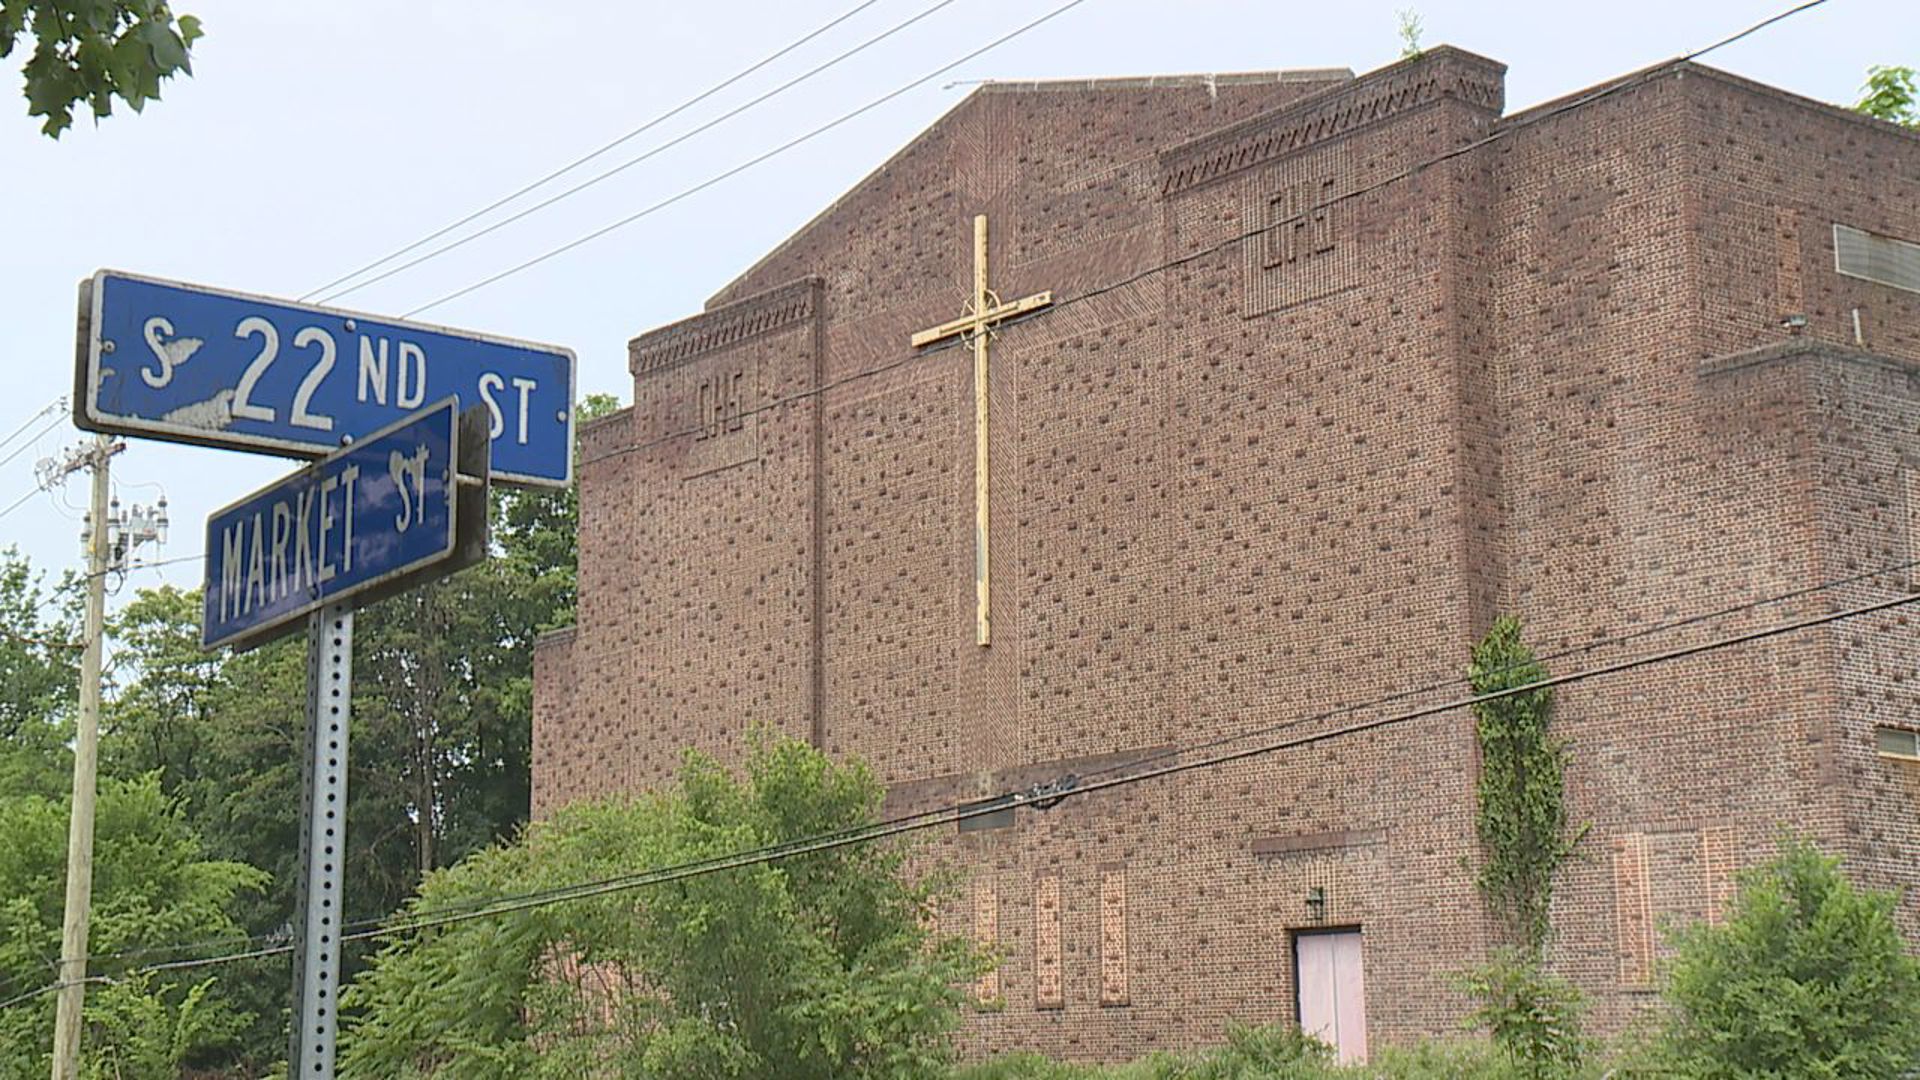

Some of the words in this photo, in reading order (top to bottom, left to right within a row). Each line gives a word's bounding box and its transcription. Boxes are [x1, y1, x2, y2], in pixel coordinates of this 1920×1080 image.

[141, 317, 175, 388] S
[478, 373, 537, 445] ST
[220, 465, 360, 624] MARKET
[389, 444, 430, 533] ST
